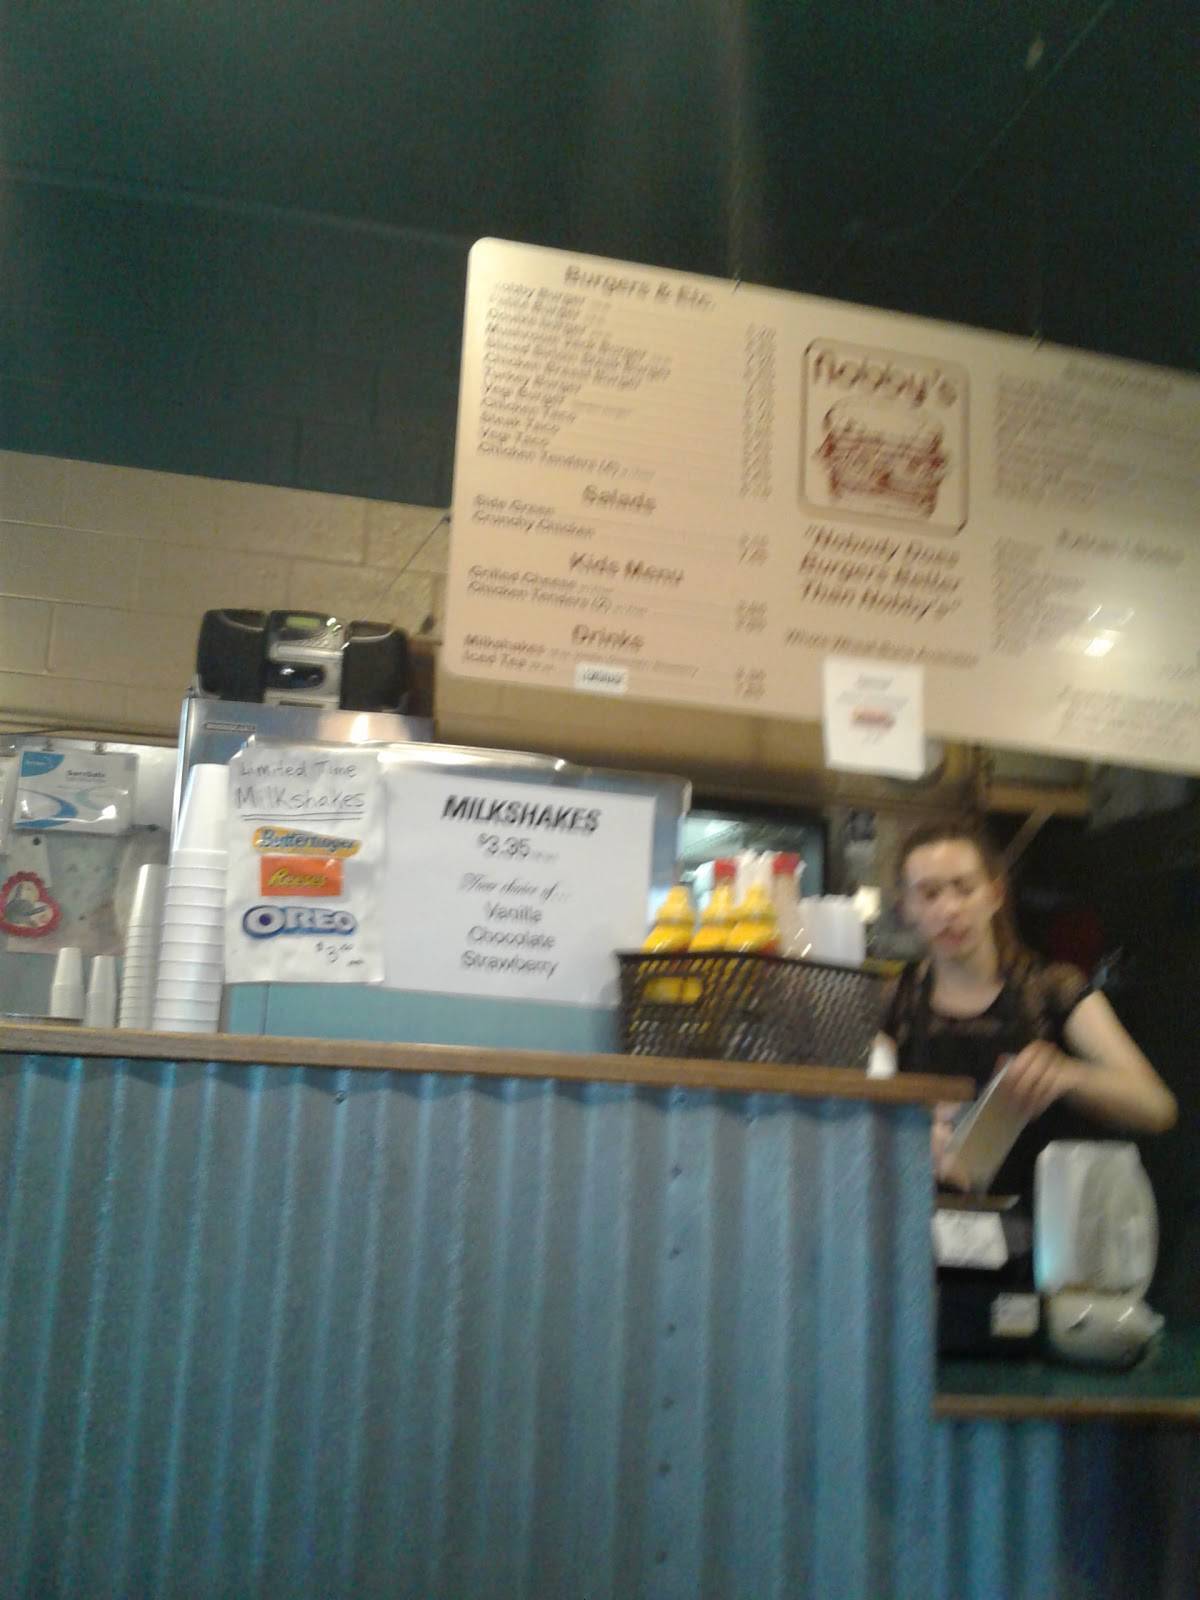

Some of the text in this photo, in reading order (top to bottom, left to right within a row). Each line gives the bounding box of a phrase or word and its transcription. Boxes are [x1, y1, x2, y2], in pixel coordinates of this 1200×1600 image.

[565, 265, 649, 296] Burgers
[535, 287, 586, 306] Burger
[532, 373, 582, 395] Burger
[582, 484, 657, 514] Salads
[467, 564, 520, 583] Grilled
[521, 570, 579, 590] Cheese
[569, 552, 686, 587] Kids Menu
[797, 550, 890, 582] Burgers
[801, 580, 857, 609] Than
[463, 633, 546, 655] Milkshakes
[571, 624, 647, 652] Drinks
[239, 758, 359, 778] Limited Time
[235, 785, 367, 811] Milkshakes
[442, 793, 603, 835] MILKSHAKES
[242, 904, 360, 939] OREO
[484, 901, 543, 922] Vanilla
[466, 923, 557, 949] Chocolate
[460, 949, 560, 980] Strawberry
